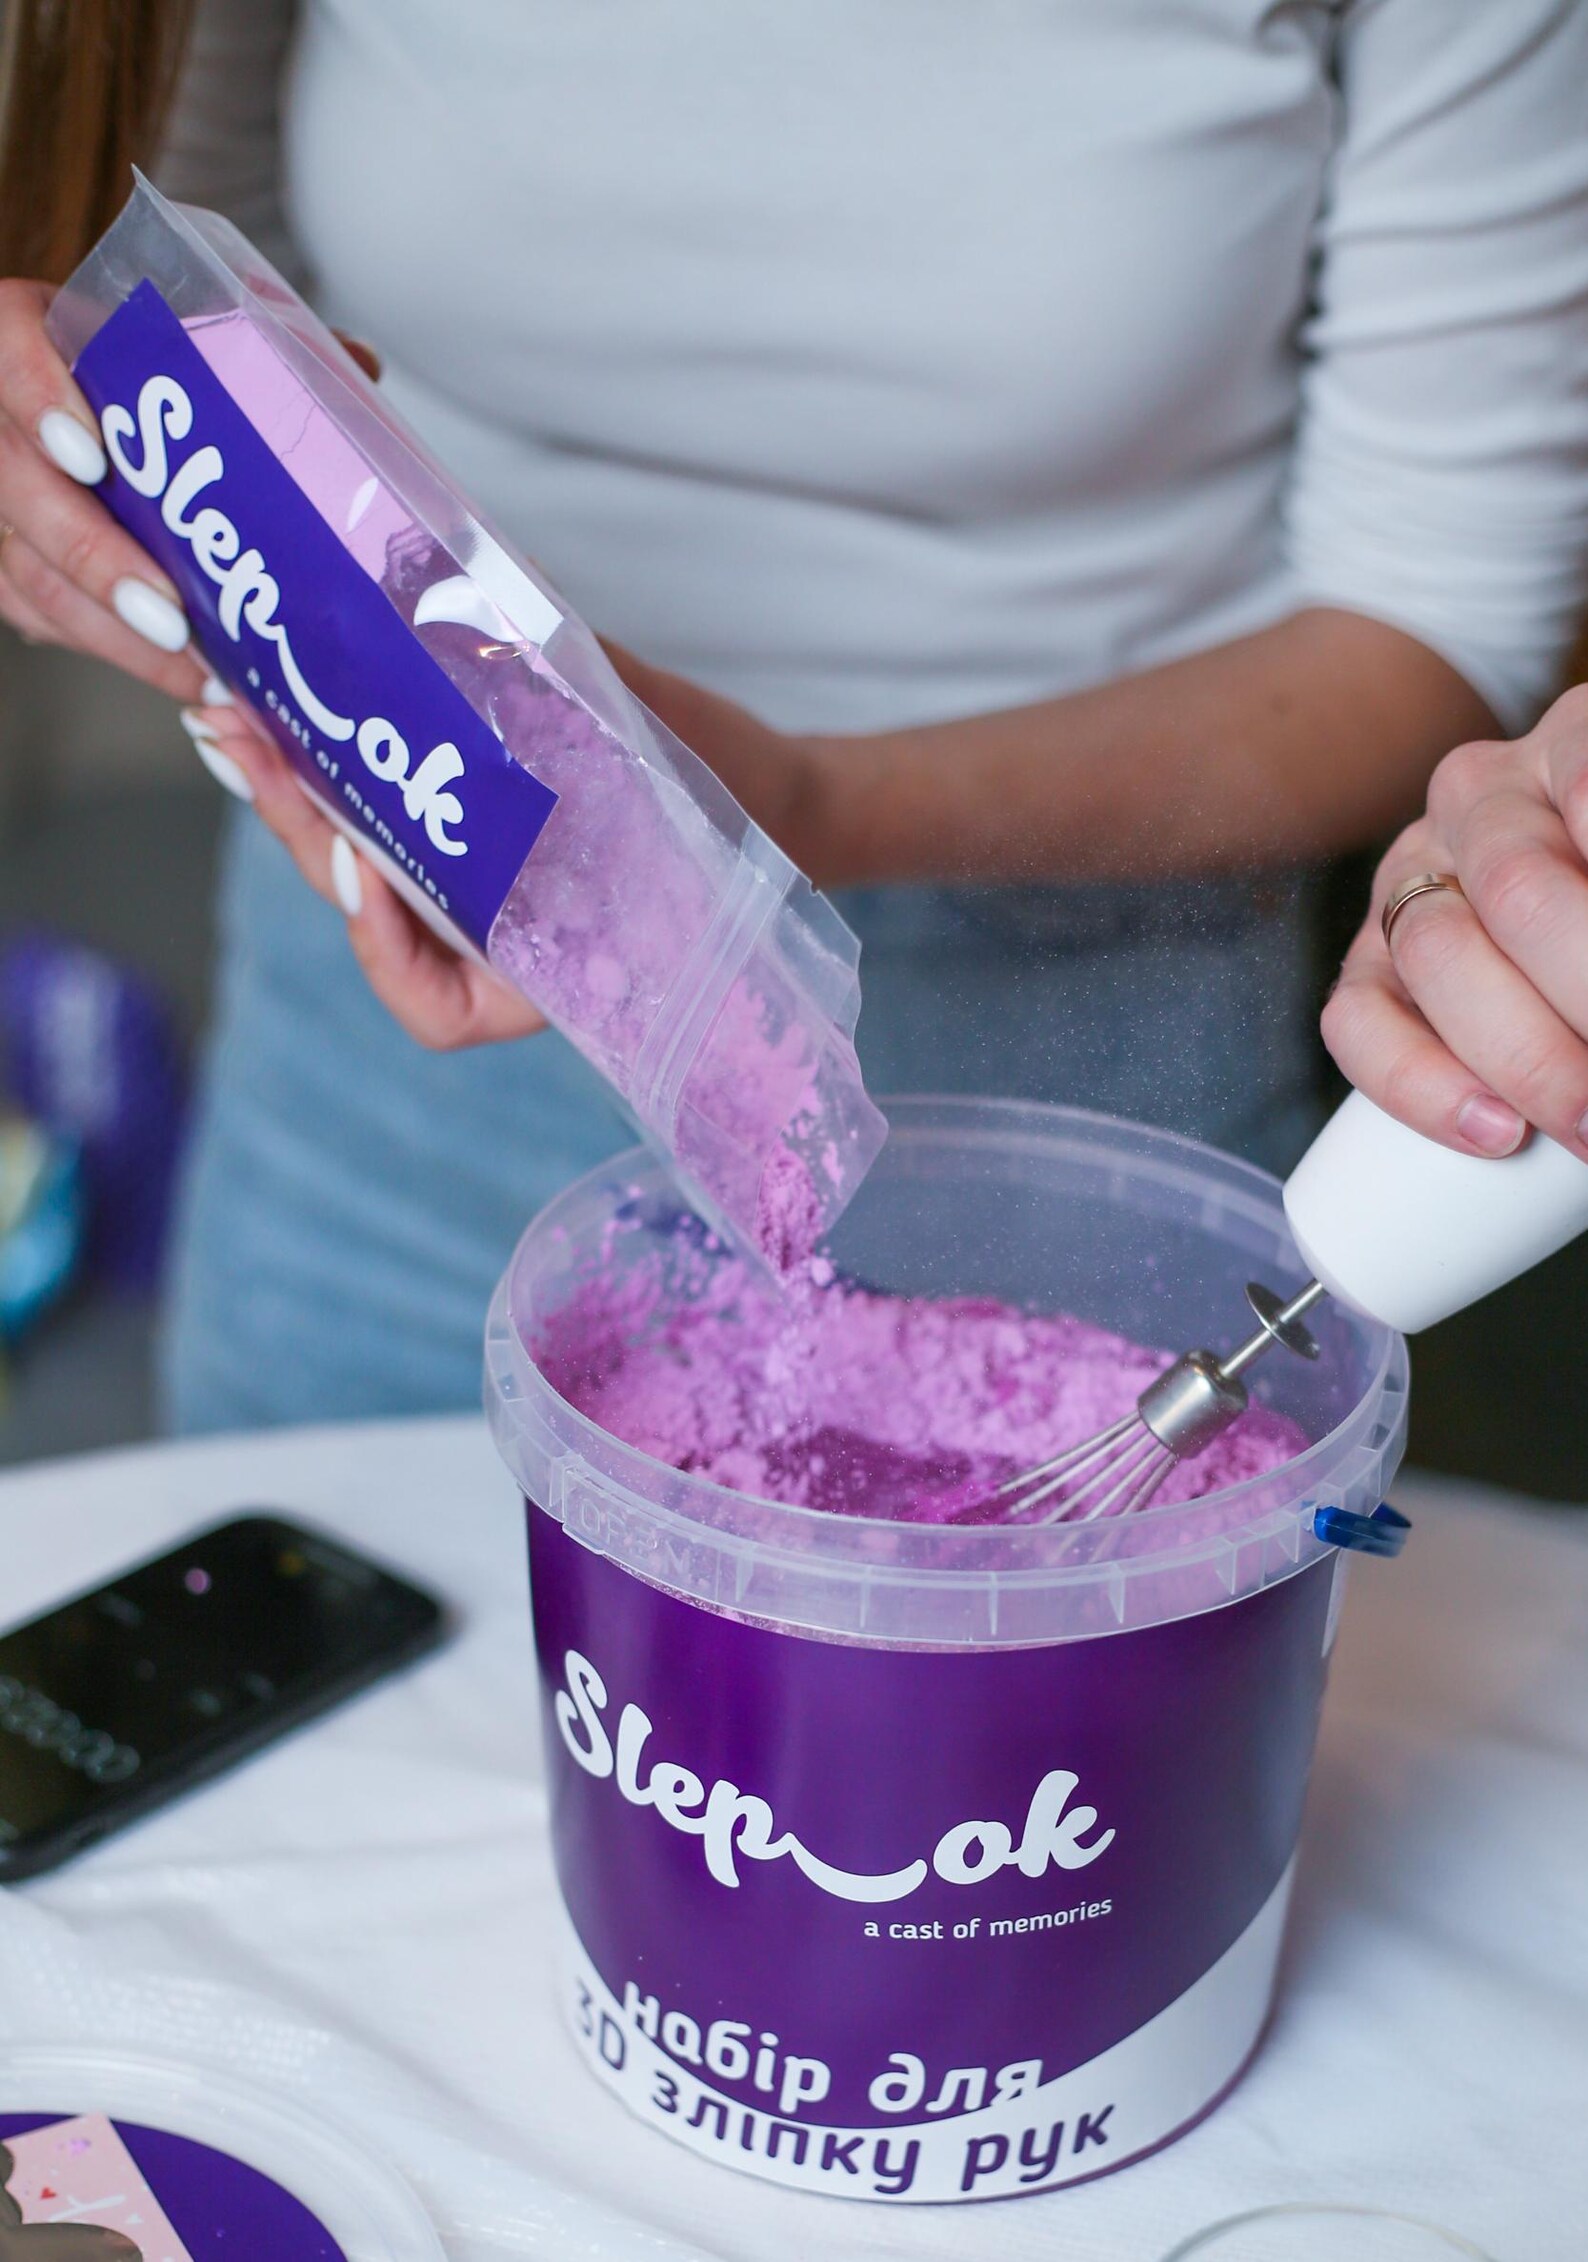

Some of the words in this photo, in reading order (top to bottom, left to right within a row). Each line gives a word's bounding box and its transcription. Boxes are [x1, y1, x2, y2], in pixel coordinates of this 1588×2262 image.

[246, 667, 261, 689] a
[264, 689, 312, 749] cast
[316, 749, 340, 781] of
[343, 781, 450, 911] memories
[863, 1921, 880, 1938] a
[889, 1920, 944, 1940] cast
[952, 1917, 982, 1939] of
[989, 1898, 1113, 1937] memories
[575, 1974, 626, 2071] 3D
[651, 2069, 922, 2195] зліпку
[960, 2103, 1115, 2193] рук
[868, 2052, 1043, 2114] для
